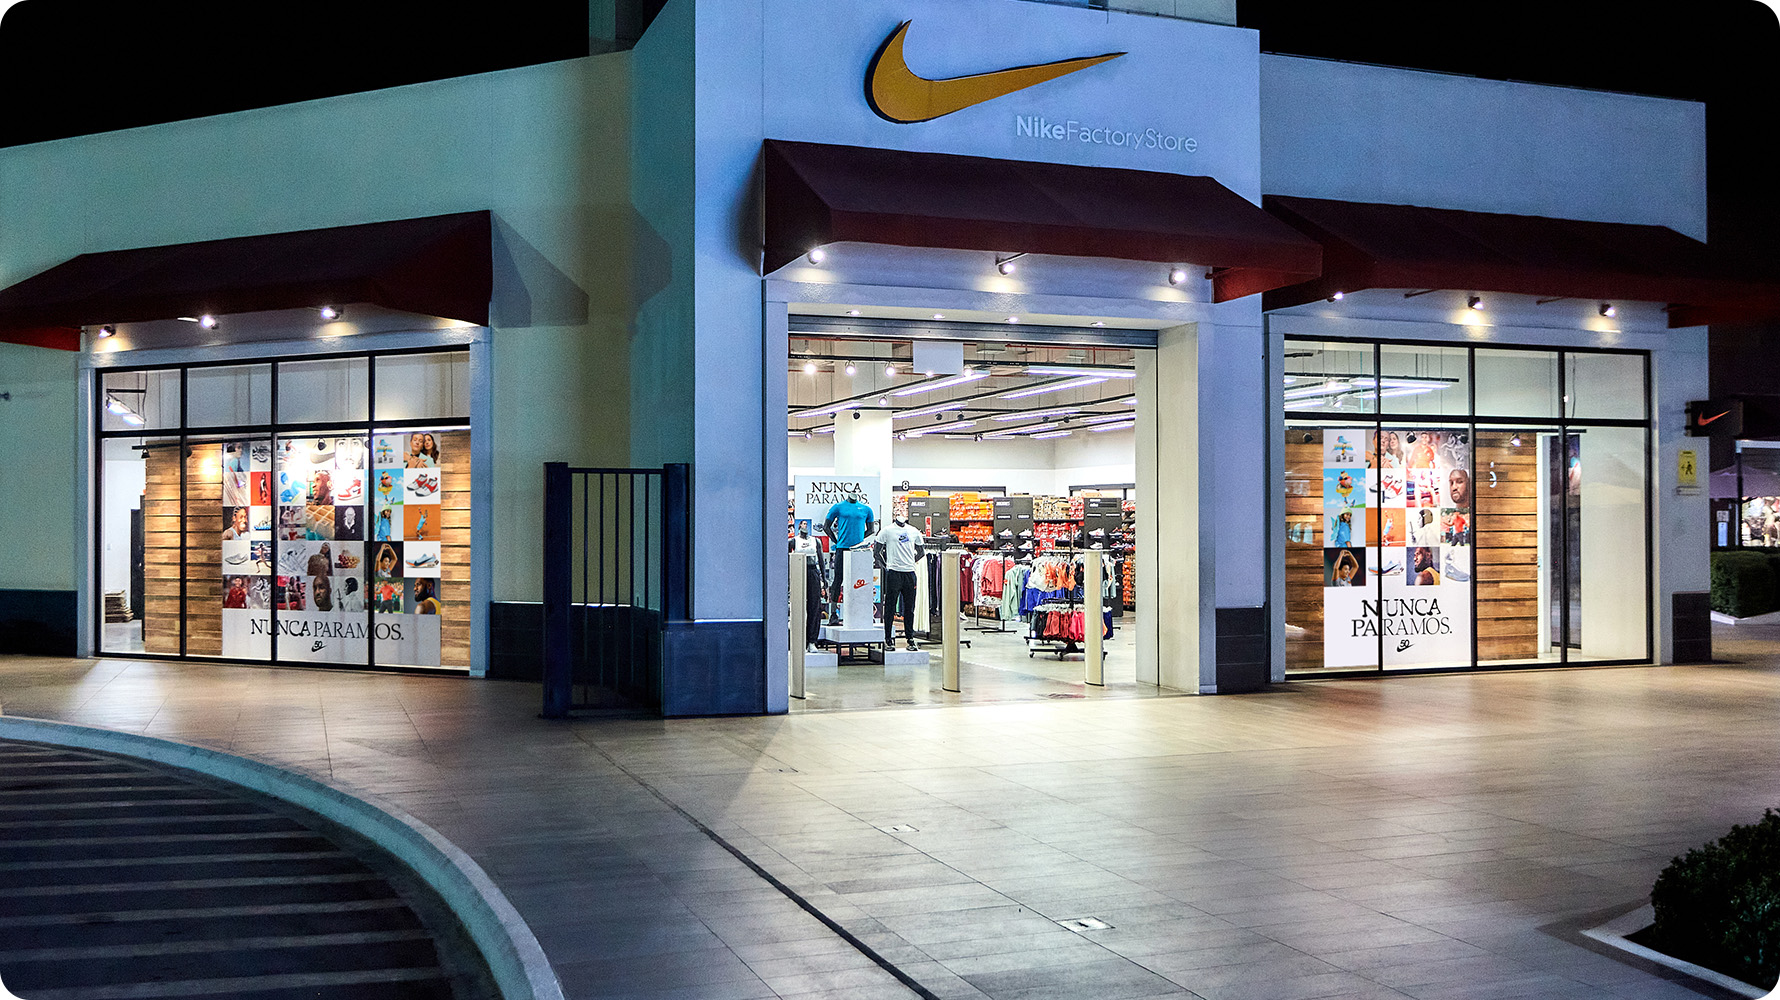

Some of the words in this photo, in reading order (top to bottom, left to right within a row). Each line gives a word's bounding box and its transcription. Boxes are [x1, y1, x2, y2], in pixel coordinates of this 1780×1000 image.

[811, 481, 862, 493] NUNCA
[806, 493, 870, 504] PARAS.
[1361, 598, 1442, 618] NUNCA
[1351, 617, 1453, 637] PARAMOS.
